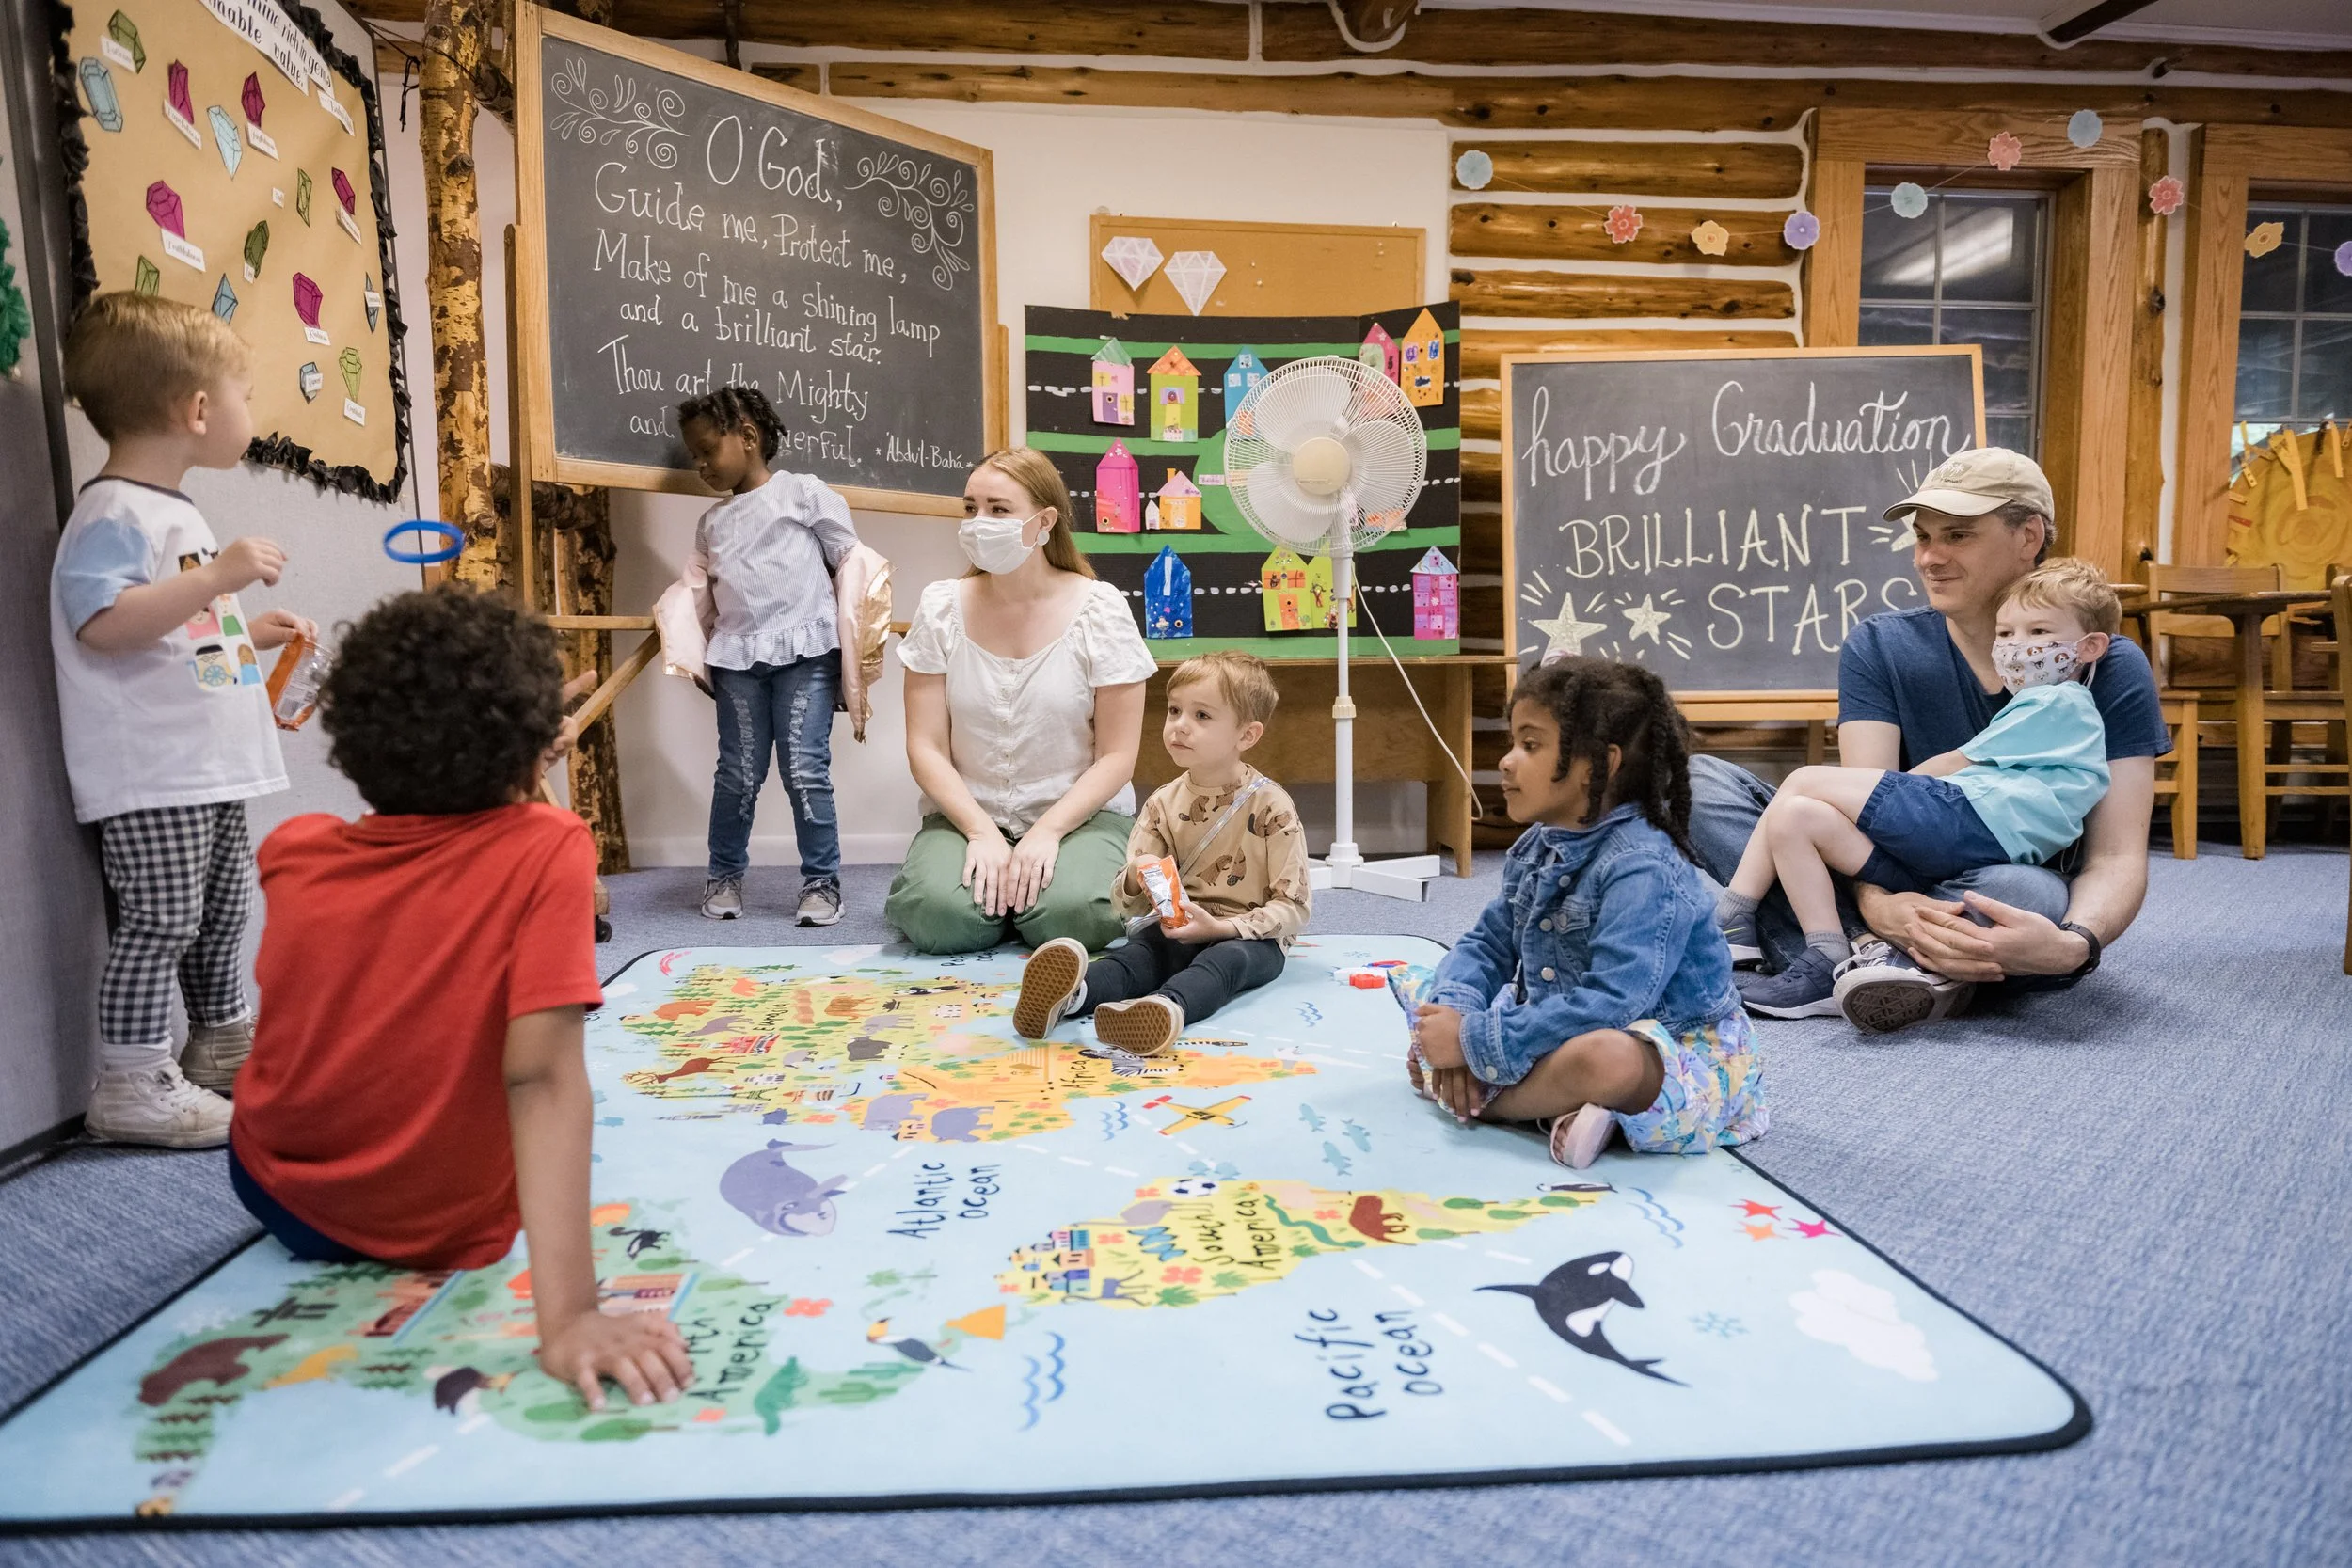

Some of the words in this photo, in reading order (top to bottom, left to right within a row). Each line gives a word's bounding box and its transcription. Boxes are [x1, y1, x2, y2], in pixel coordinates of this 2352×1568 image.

[281, 23, 299, 53] rich
[300, 39, 307, 62] in
[308, 55, 331, 87] gems
[758, 126, 843, 212] God,
[595, 162, 705, 232] Guide
[722, 213, 768, 249] me,
[771, 214, 851, 268] Protect
[862, 249, 907, 284] me,
[592, 228, 671, 285] Make
[683, 252, 710, 298] of
[723, 275, 757, 306] me
[772, 290, 788, 309] a
[802, 282, 877, 343] shining
[888, 296, 941, 358] lamp
[620, 294, 662, 325] and
[681, 312, 699, 332] a
[714, 306, 817, 354] brilliant
[828, 332, 882, 365] star.
[597, 334, 664, 395] Thou
[675, 358, 713, 395] art
[776, 370, 868, 425] Mighty
[630, 406, 675, 438] and
[777, 425, 862, 467] werful.
[1521, 386, 1687, 501] happy
[1711, 380, 1972, 458] Graduation
[1558, 504, 1867, 579] BRILLIANT
[1059, 1059, 1099, 1089] Africa
[886, 1162, 954, 1239] Atlantic
[1234, 1198, 1282, 1271] America
[1178, 1214, 1235, 1267] South
[686, 1293, 787, 1403] America
[1294, 1307, 1388, 1419] Pacific
